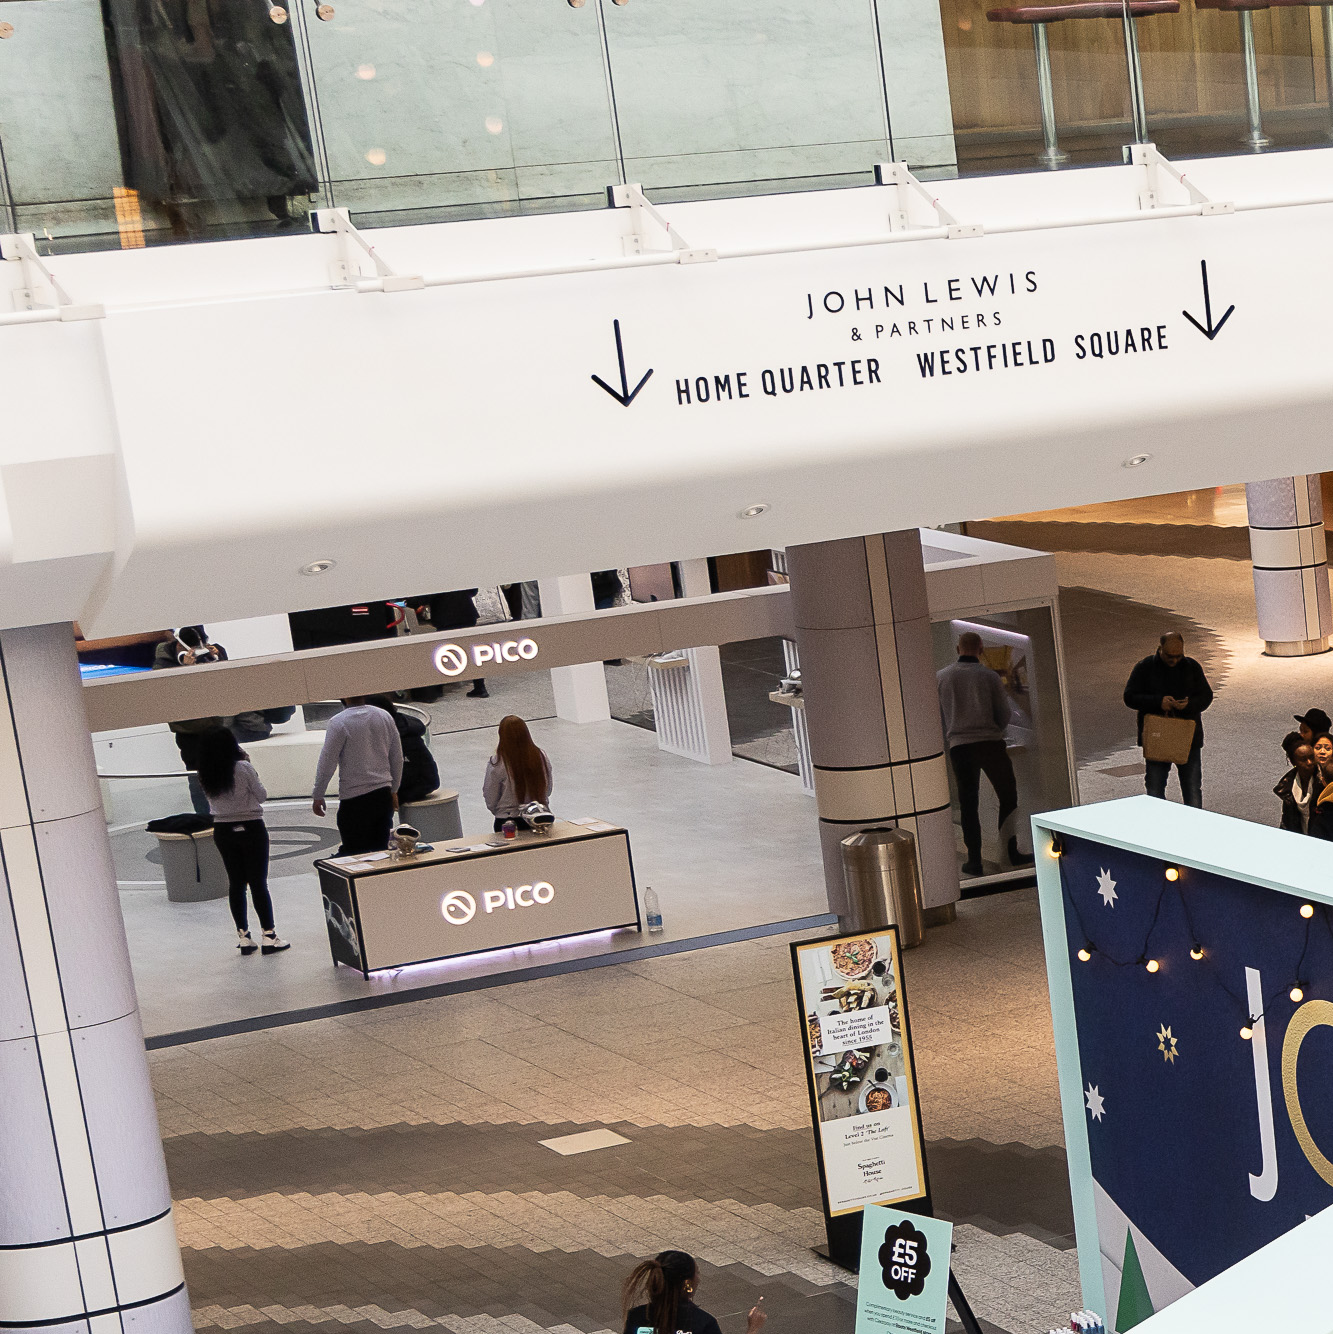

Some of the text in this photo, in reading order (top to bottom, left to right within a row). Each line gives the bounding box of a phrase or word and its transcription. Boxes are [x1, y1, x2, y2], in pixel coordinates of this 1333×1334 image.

[805, 270, 1039, 319] JOHN LEWIS
[851, 311, 1002, 341] & PARTNERS
[675, 325, 1169, 406] HOME QUARTER WESTFIELD SQUARE
[473, 638, 538, 666] PICO
[484, 881, 555, 914] PICO
[858, 1160, 885, 1170] Spaghetti
[892, 1238, 918, 1266] £5
[891, 1264, 916, 1283] OFF
